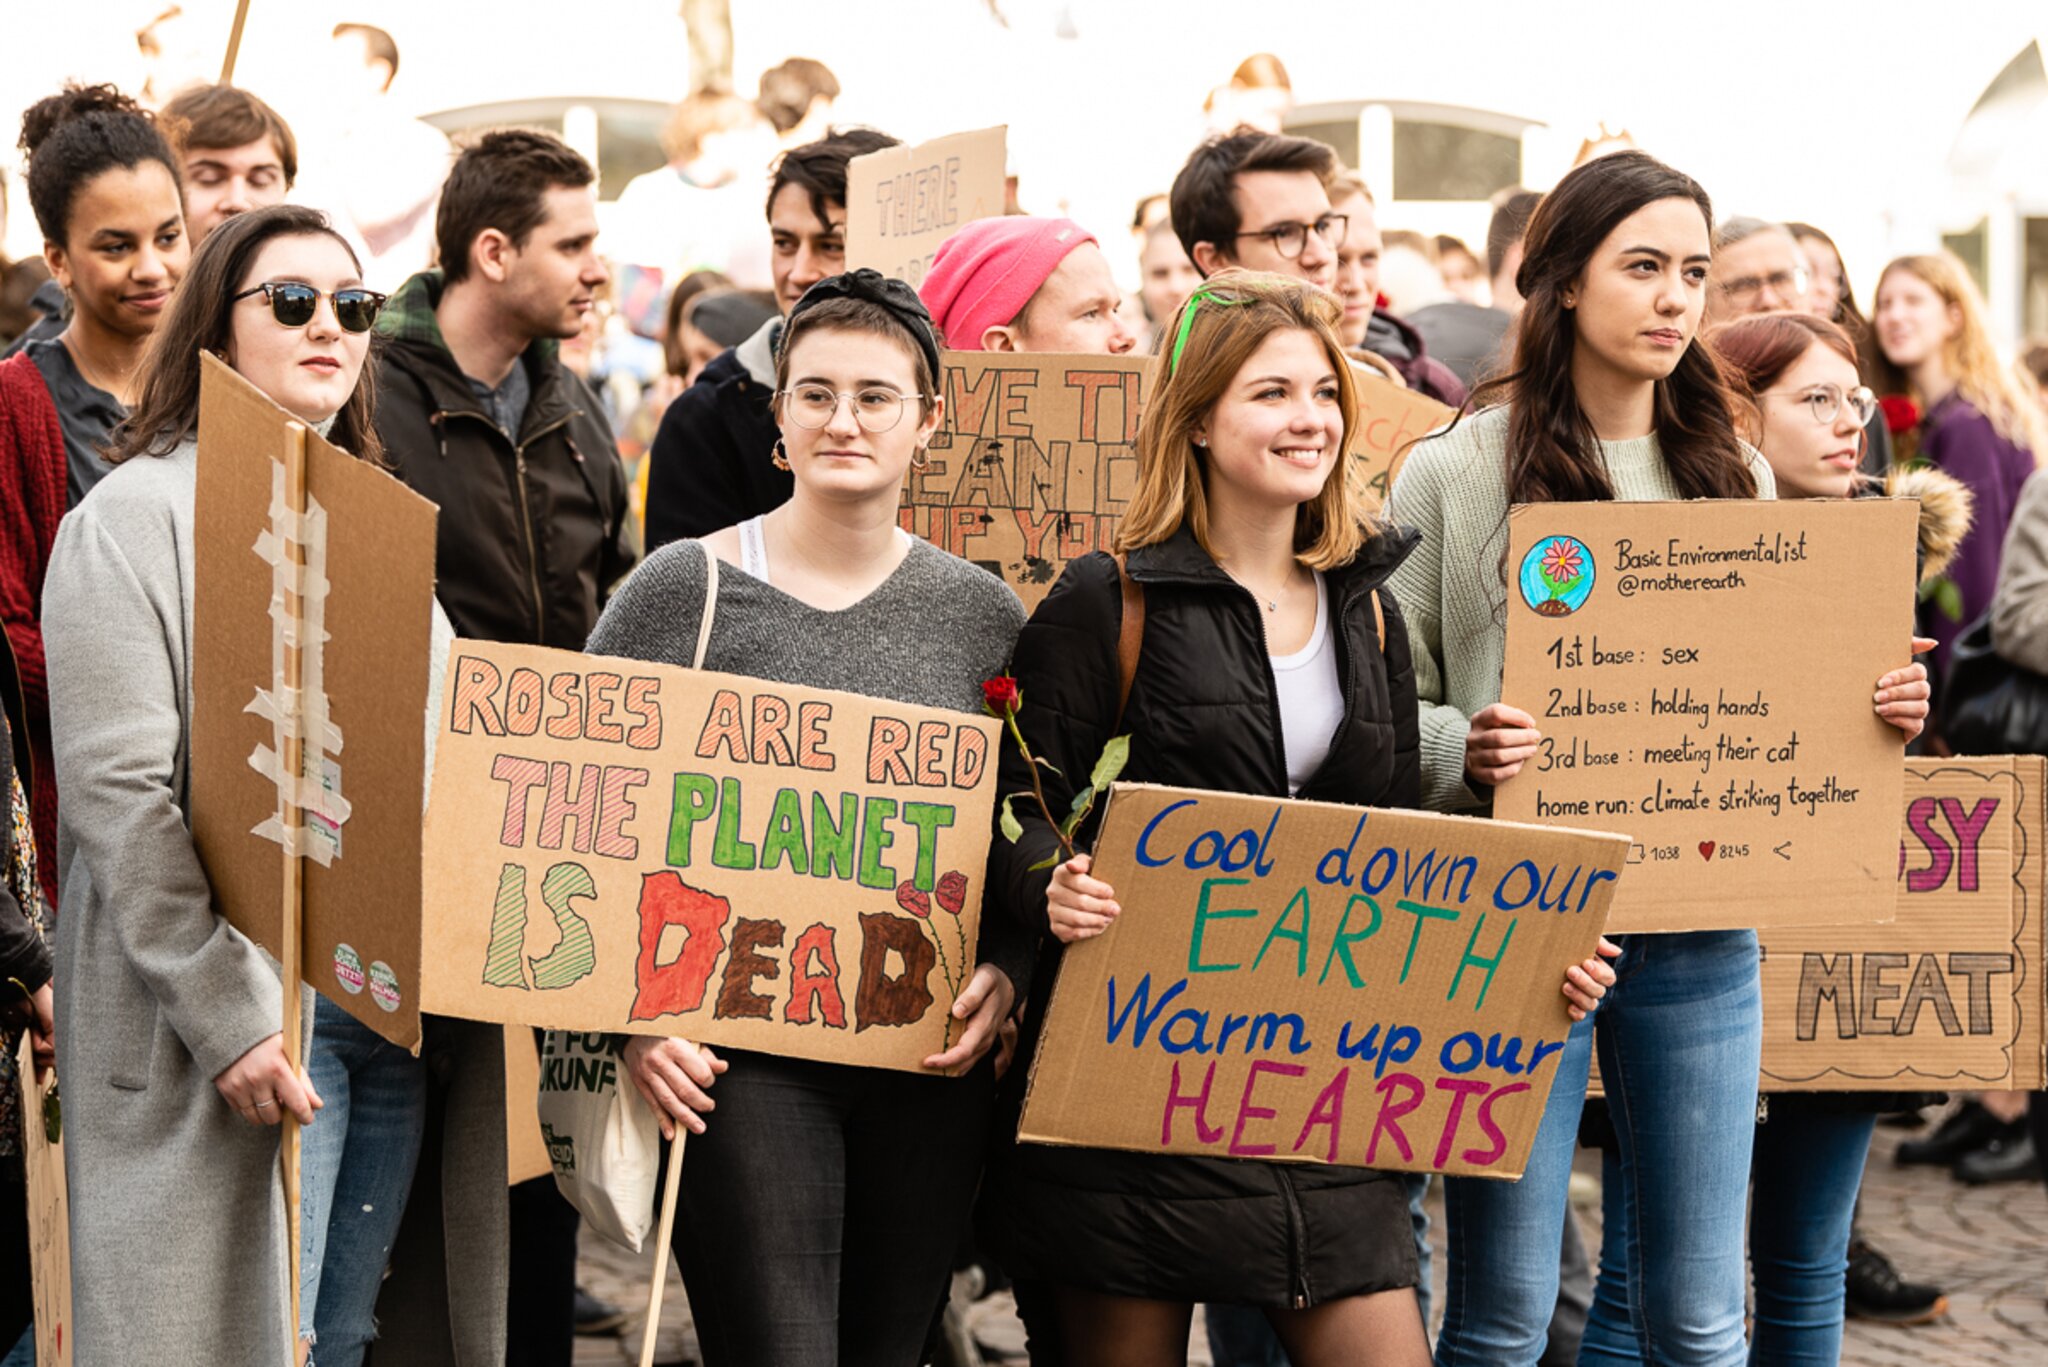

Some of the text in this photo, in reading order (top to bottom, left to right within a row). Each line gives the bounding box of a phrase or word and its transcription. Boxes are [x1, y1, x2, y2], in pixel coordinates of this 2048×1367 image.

[876, 157, 960, 237] THERE
[900, 432, 1070, 514] EAN
[1614, 538, 1662, 571] Basic
[1617, 570, 1746, 597] @motherearth
[1547, 634, 1583, 669] 1st
[1662, 647, 1699, 665] sex
[451, 655, 988, 789] ROSES ARE RED
[1545, 687, 1583, 717] 2nd
[1651, 687, 1710, 729] holding
[1717, 687, 1769, 717] hands
[1537, 736, 1577, 771] 3rd
[1644, 734, 1711, 774] meeting
[1716, 733, 1760, 761] their
[1766, 731, 1799, 763] cat
[491, 754, 955, 892] THE PLANET
[1537, 790, 1589, 817] home
[1641, 778, 1710, 813] climate
[1719, 779, 1781, 816] striking
[1787, 776, 1859, 816] together
[1135, 799, 1617, 913] Cool down our
[1650, 846, 1680, 861] 1038
[1719, 844, 1750, 859] 8245
[1898, 797, 2001, 892] SY
[482, 862, 937, 1033] IS DEAD
[1188, 878, 1517, 1012] EARTH
[1107, 972, 1565, 1080] Warm up our
[1796, 952, 2014, 1042] MEAT
[540, 1056, 617, 1098] KUNF
[1161, 1059, 1532, 1170] HEARTS
